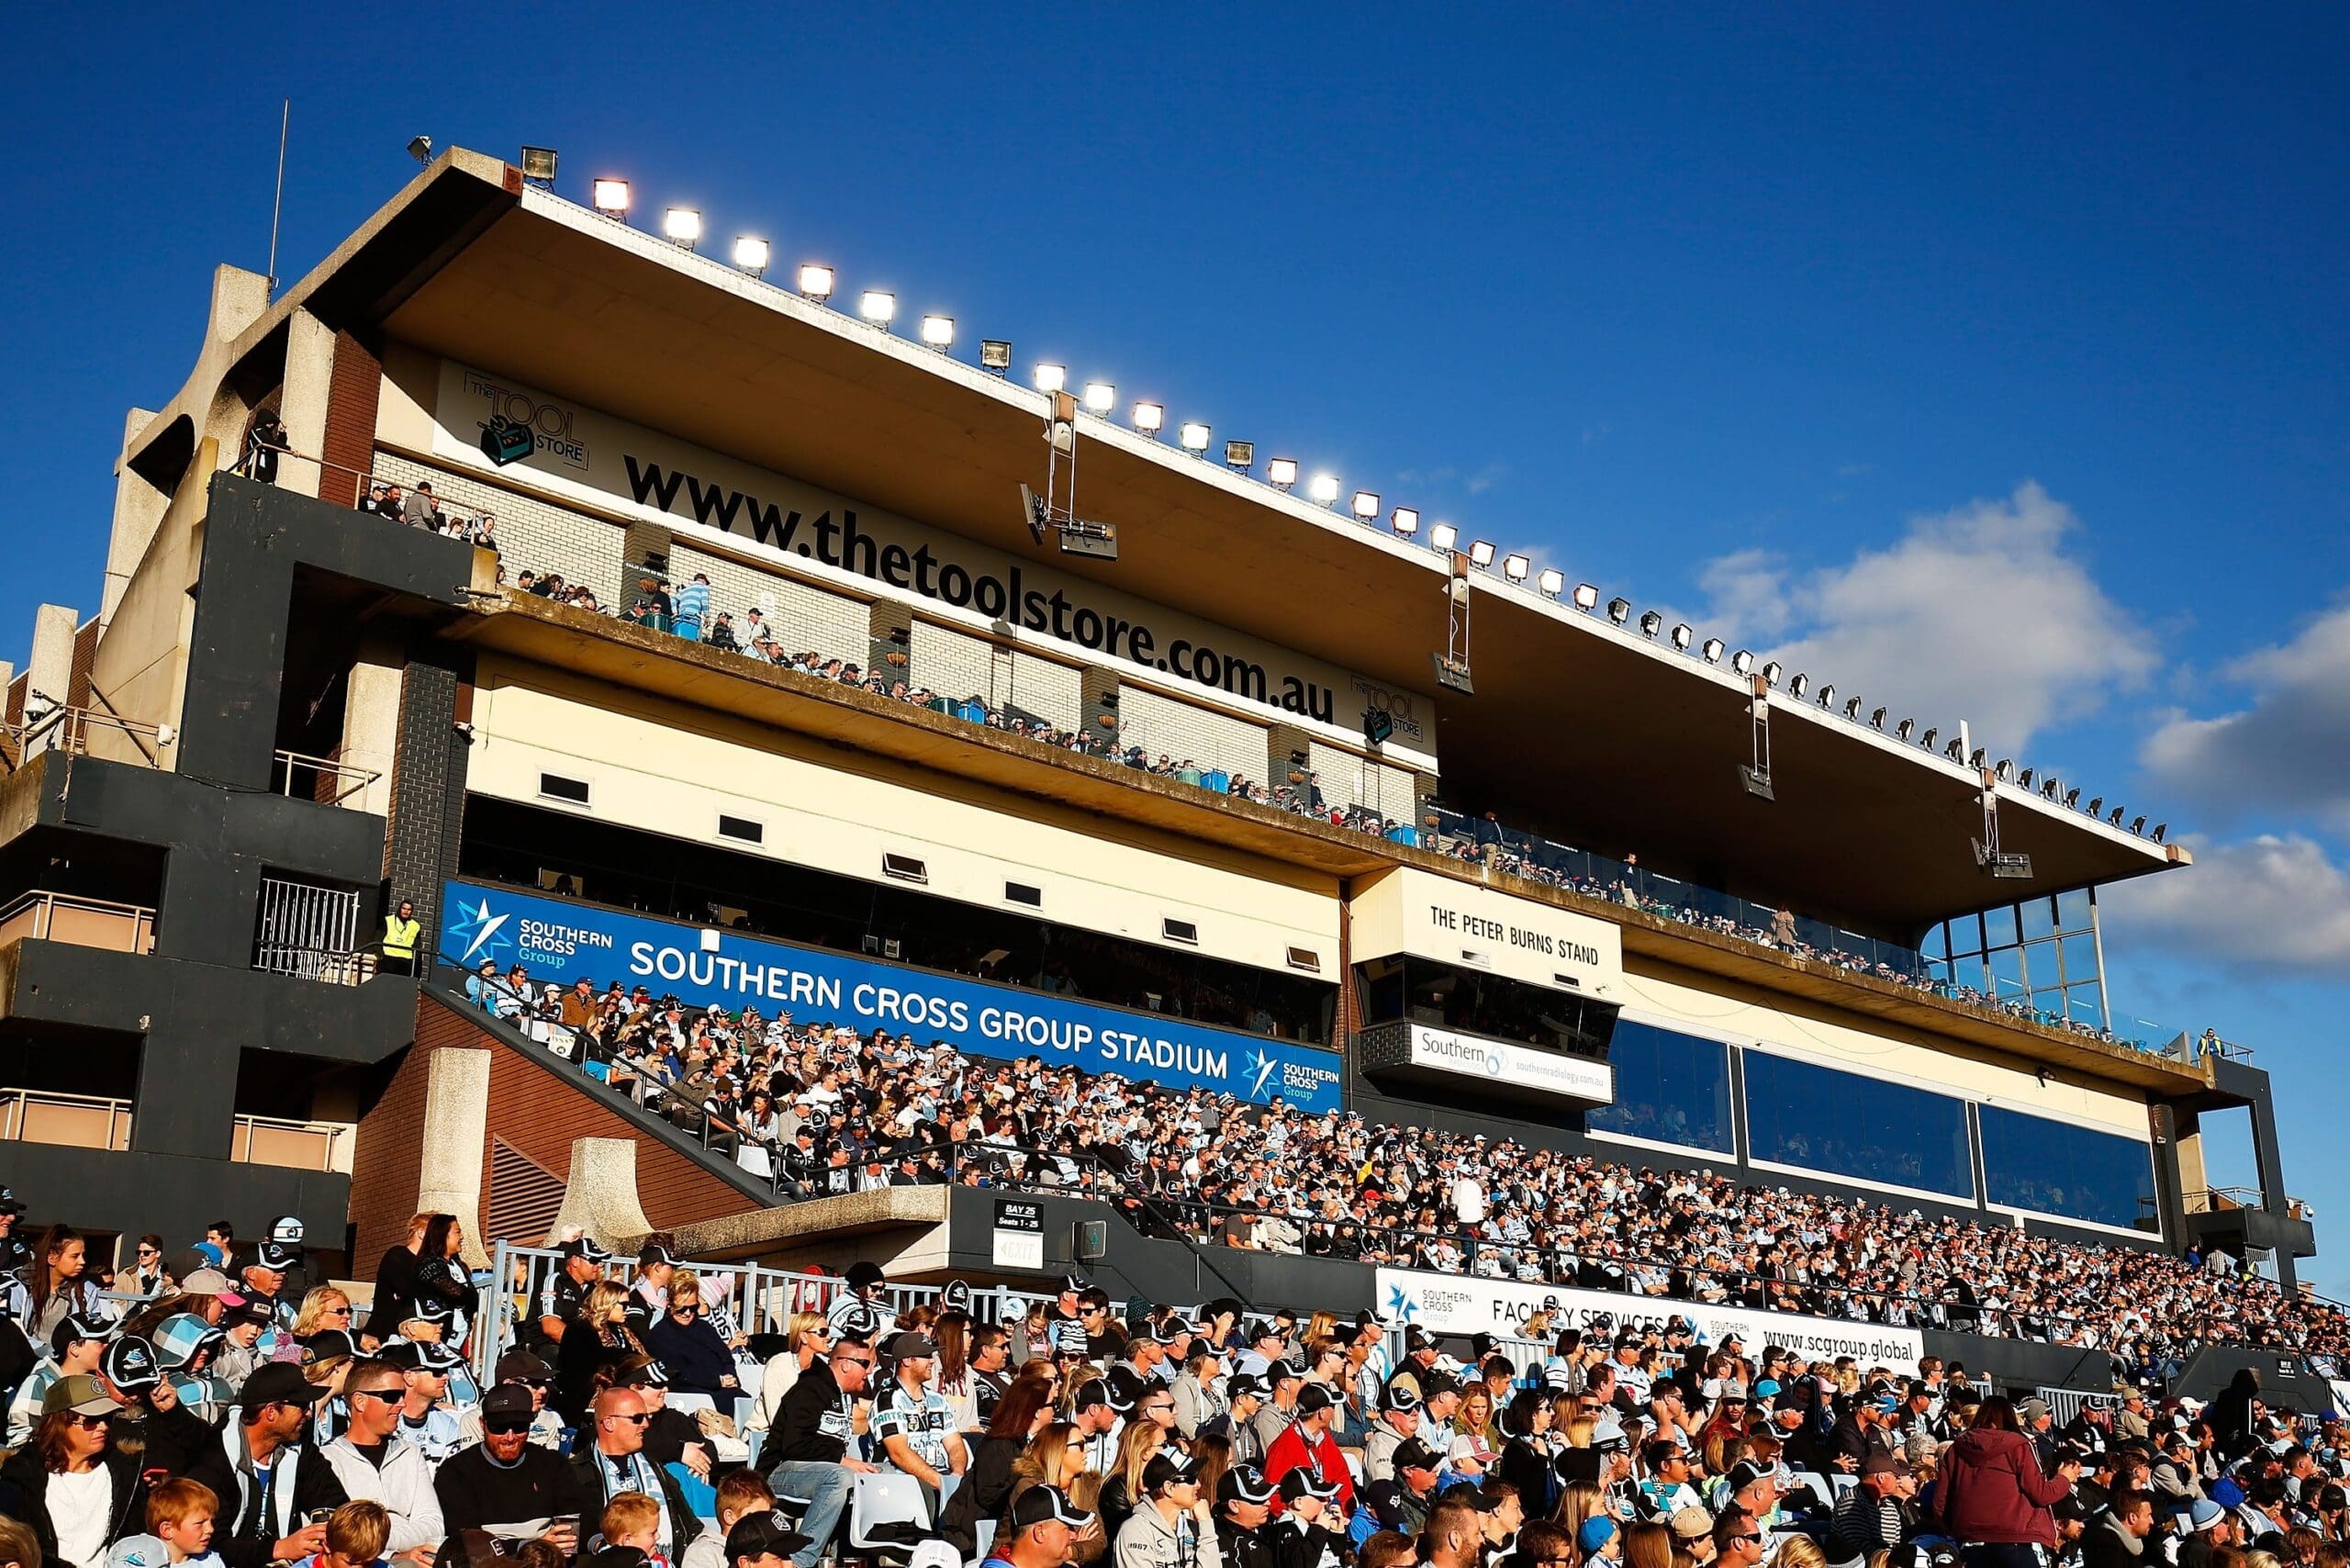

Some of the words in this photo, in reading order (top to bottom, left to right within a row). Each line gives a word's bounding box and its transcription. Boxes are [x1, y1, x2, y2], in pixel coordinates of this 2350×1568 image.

[471, 381, 493, 398] The
[485, 382, 584, 447] TOOL
[536, 434, 583, 462] STORE
[623, 454, 1334, 725] www.thetoolstore.com.au
[1363, 683, 1419, 724] TOOL
[1393, 718, 1419, 737] STORE
[520, 919, 612, 948] SOUTHERN
[1431, 905, 1456, 930] THE
[1462, 914, 1504, 942] PETER
[1510, 927, 1552, 955] BURNS
[1559, 939, 1598, 966] STAND
[519, 934, 576, 956] CROSS
[519, 947, 565, 969] Group
[630, 942, 841, 1009] SOUTHERN
[853, 983, 968, 1033] CROSS
[979, 1007, 1092, 1050] GROUP
[1100, 1030, 1227, 1080] STADIUM
[1422, 1033, 1484, 1063] Southern
[1283, 1063, 1339, 1084] SOUTHERN
[1283, 1074, 1318, 1091] CROSS
[1516, 1061, 1604, 1087] southernradiology.com.au
[1284, 1085, 1313, 1102] Group
[1005, 1204, 1024, 1215] BAY
[1024, 1206, 1036, 1215] 25
[999, 1217, 1018, 1226] Seats
[1029, 1220, 1039, 1228] 25
[1007, 1241, 1035, 1260] EXIT
[1423, 1289, 1472, 1303] SOUTHERN
[1423, 1300, 1453, 1313] CROSS
[1423, 1311, 1449, 1326] Group
[1710, 1320, 1750, 1332] SOUTHERN
[1763, 1331, 1914, 1362] www.scgroup.global
